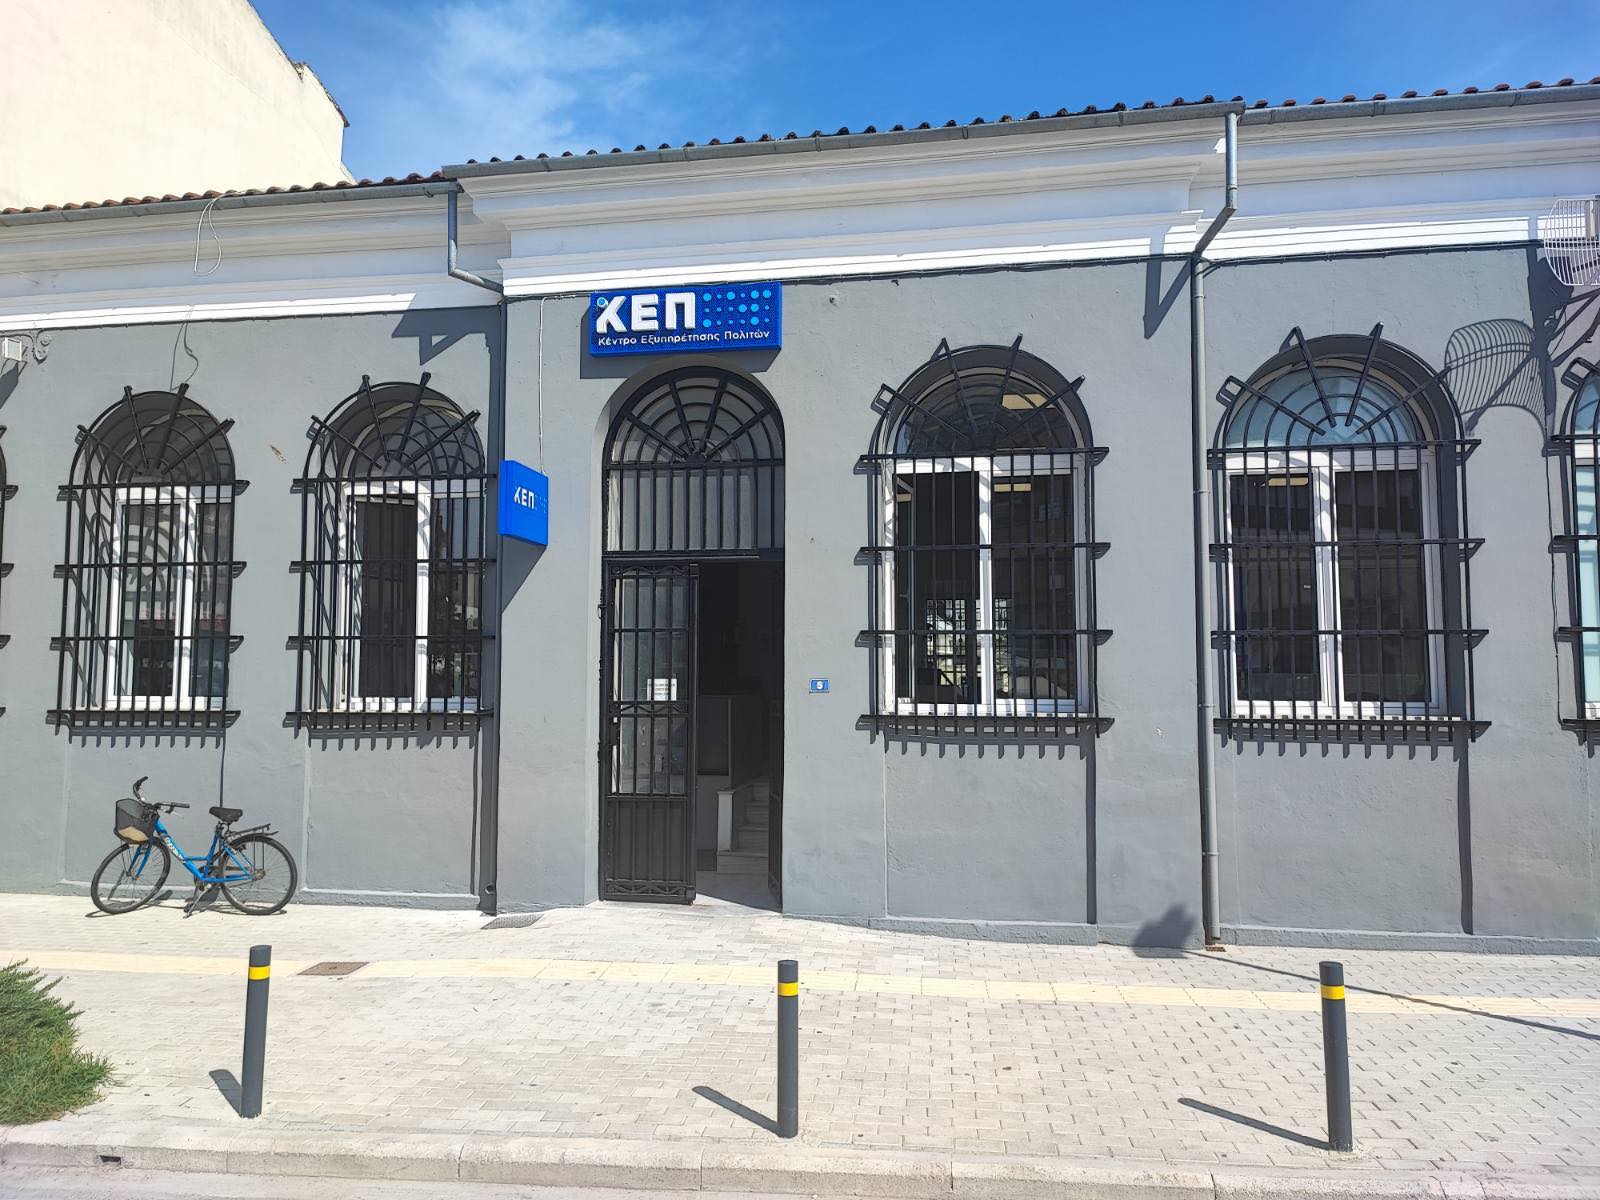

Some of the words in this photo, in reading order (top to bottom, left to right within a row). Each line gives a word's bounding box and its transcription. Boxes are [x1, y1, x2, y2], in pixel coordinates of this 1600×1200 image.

[596, 292, 696, 334] ΚΕΠ
[598, 336, 638, 347] Κέντρο
[640, 331, 721, 345] Εξυπηρέτησης
[724, 328, 771, 341] Πολιτών
[514, 486, 535, 510] ΚΕΠ
[816, 681, 823, 690] 5
